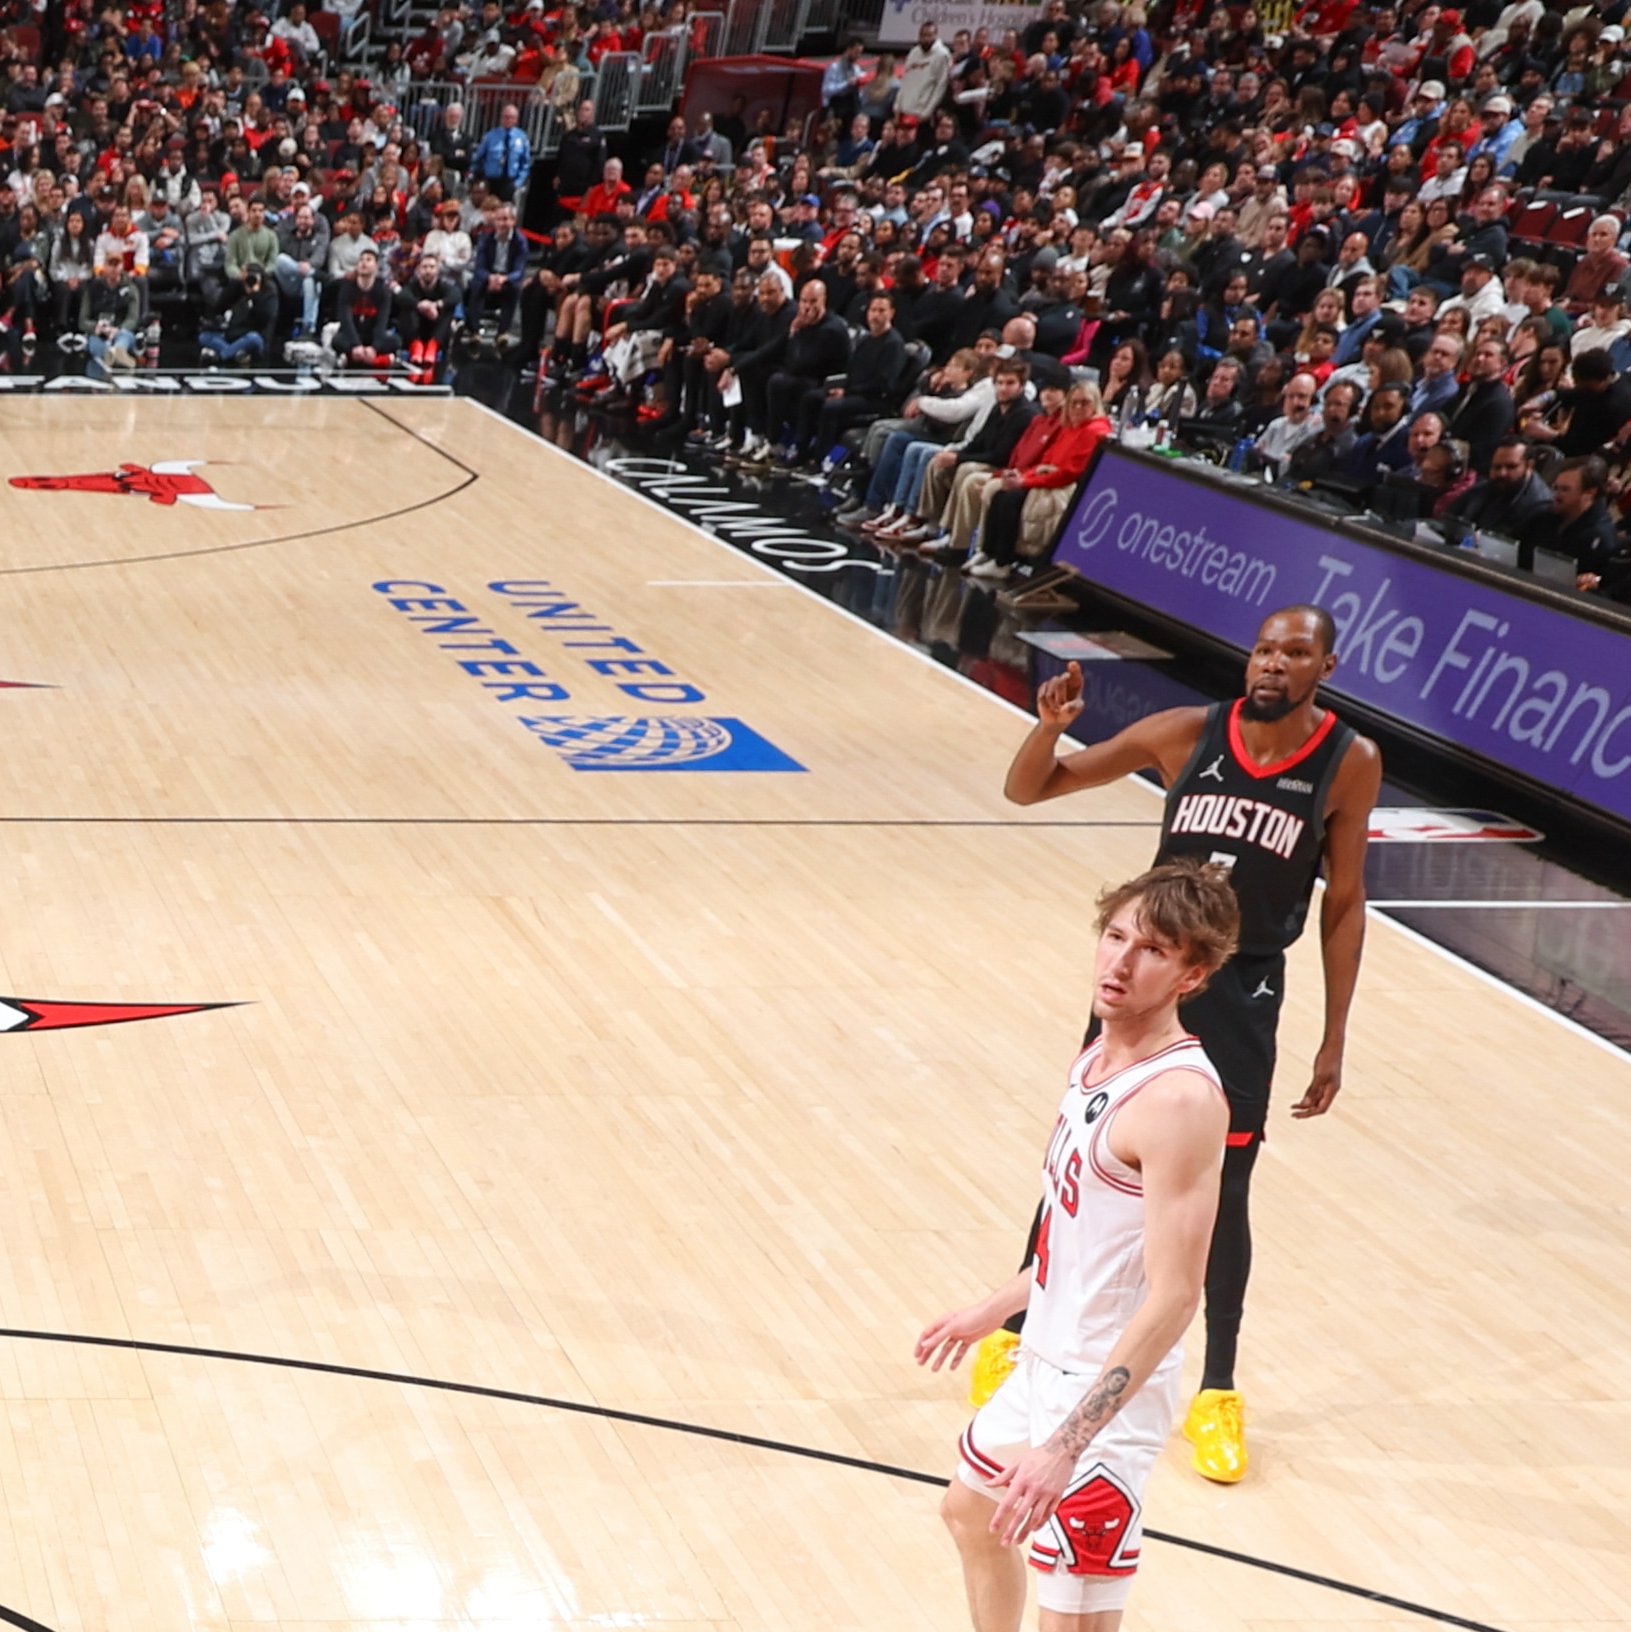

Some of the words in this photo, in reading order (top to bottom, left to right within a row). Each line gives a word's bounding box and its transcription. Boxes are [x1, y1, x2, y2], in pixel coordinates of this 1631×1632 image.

[605, 458, 883, 572] CALAMOS
[371, 580, 571, 701] CENTER
[487, 580, 706, 704] UNITED
[1118, 513, 1277, 607] onestream
[1311, 554, 1425, 685] Take
[1170, 794, 1304, 860] HOUSTON
